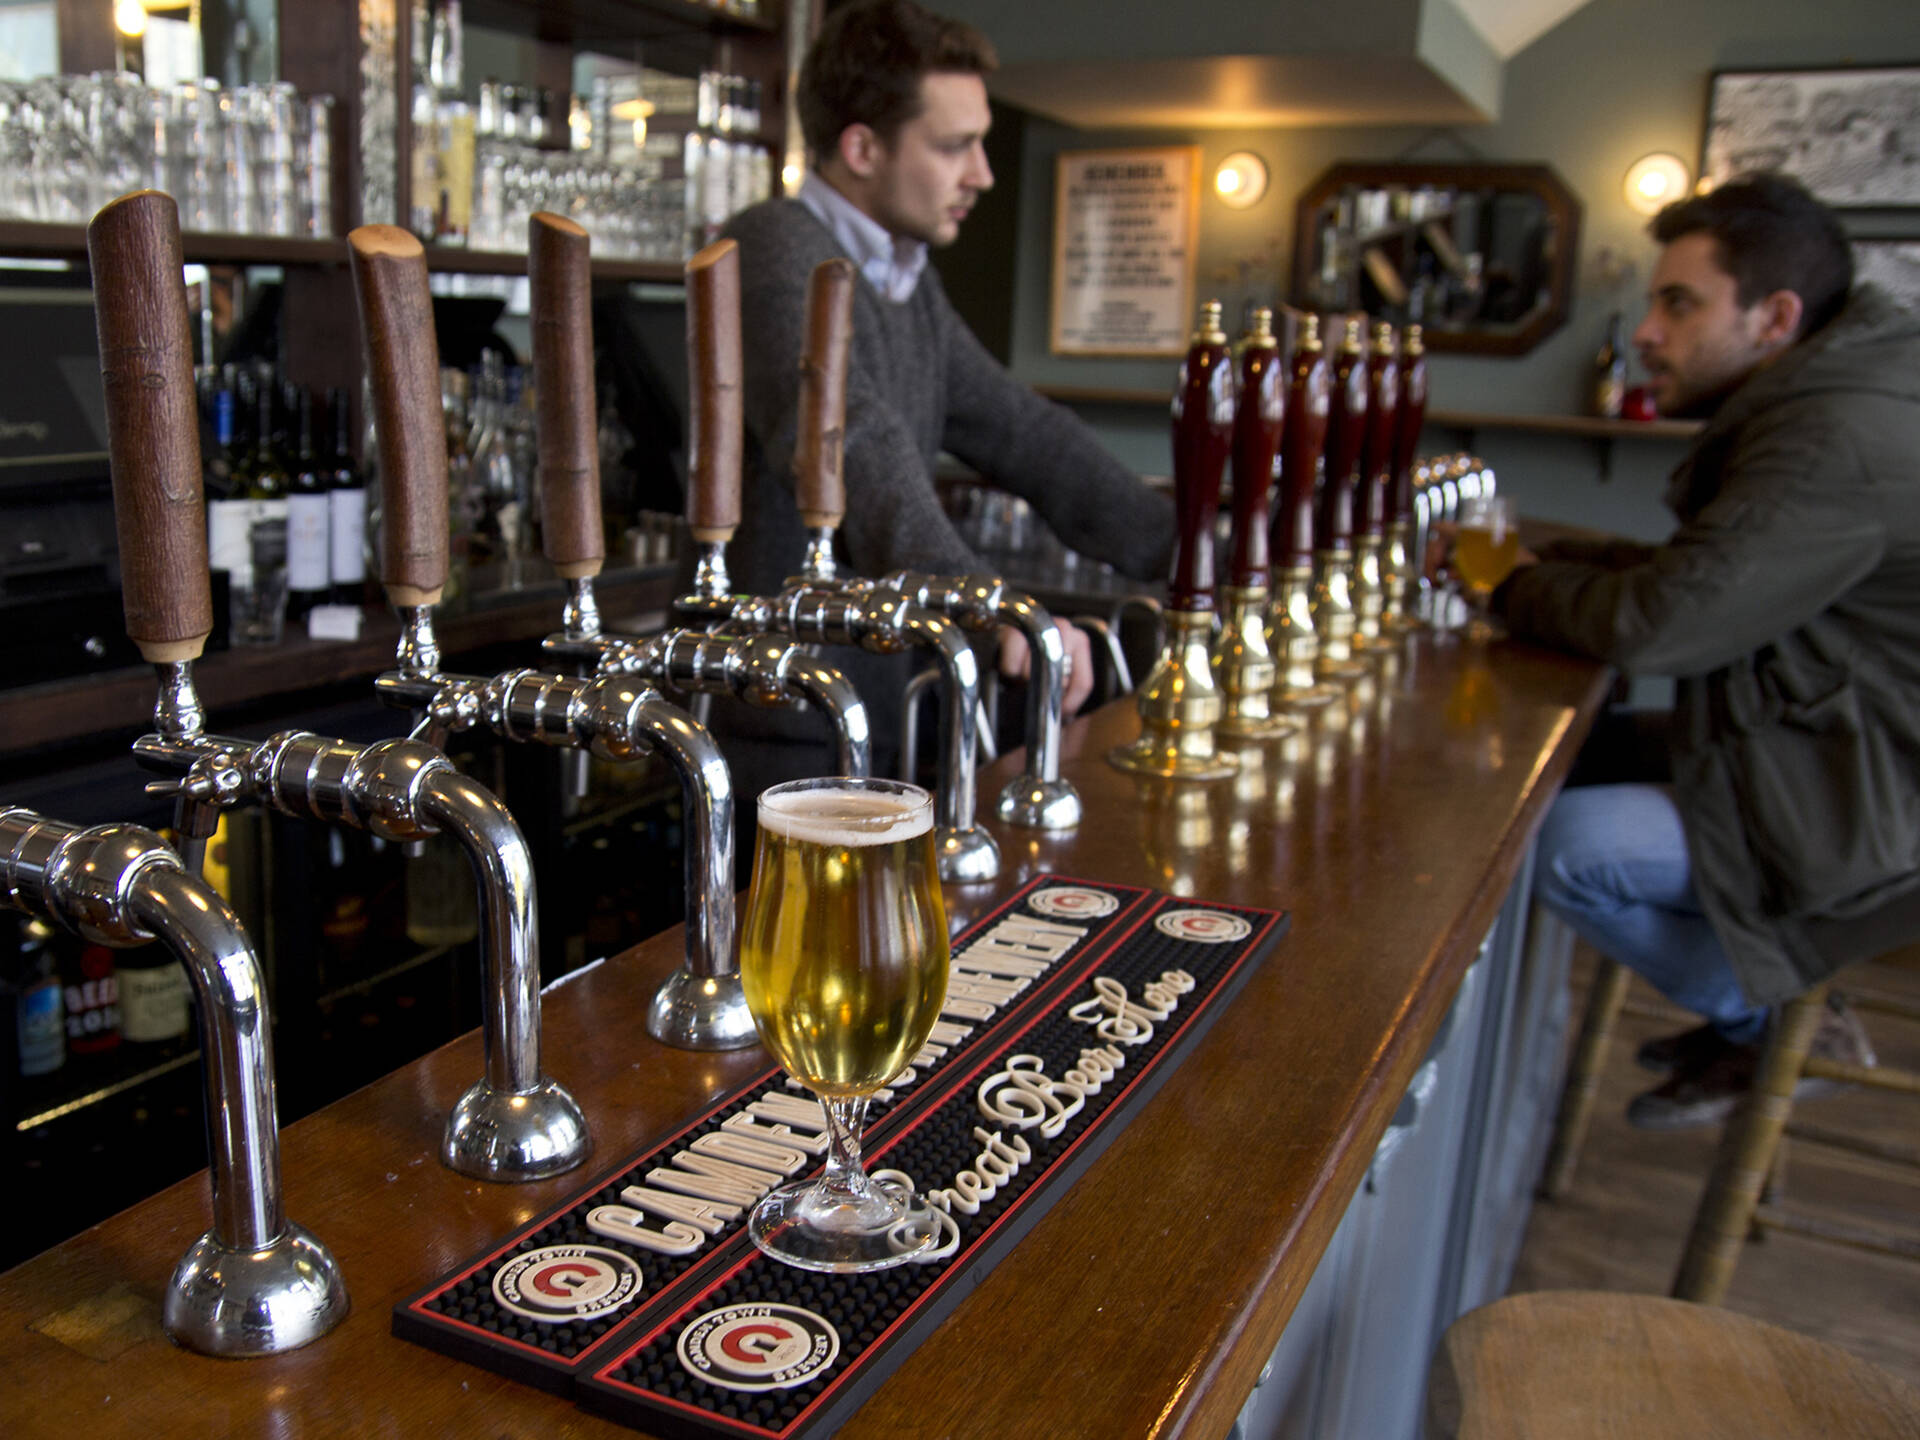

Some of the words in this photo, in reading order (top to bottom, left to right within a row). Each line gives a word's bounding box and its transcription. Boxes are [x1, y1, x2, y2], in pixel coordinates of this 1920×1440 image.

[868, 1126, 1031, 1265] Great
[978, 1044, 1125, 1139] Beer
[1068, 968, 1196, 1047] Here
[586, 1090, 840, 1256] CAMDEN
[503, 1261, 531, 1303] CAMDEN
[529, 1249, 587, 1263] TOWN
[689, 1322, 713, 1371] CAMDEN
[711, 1307, 772, 1325] TOWN
[772, 1333, 829, 1383] BREWERY
